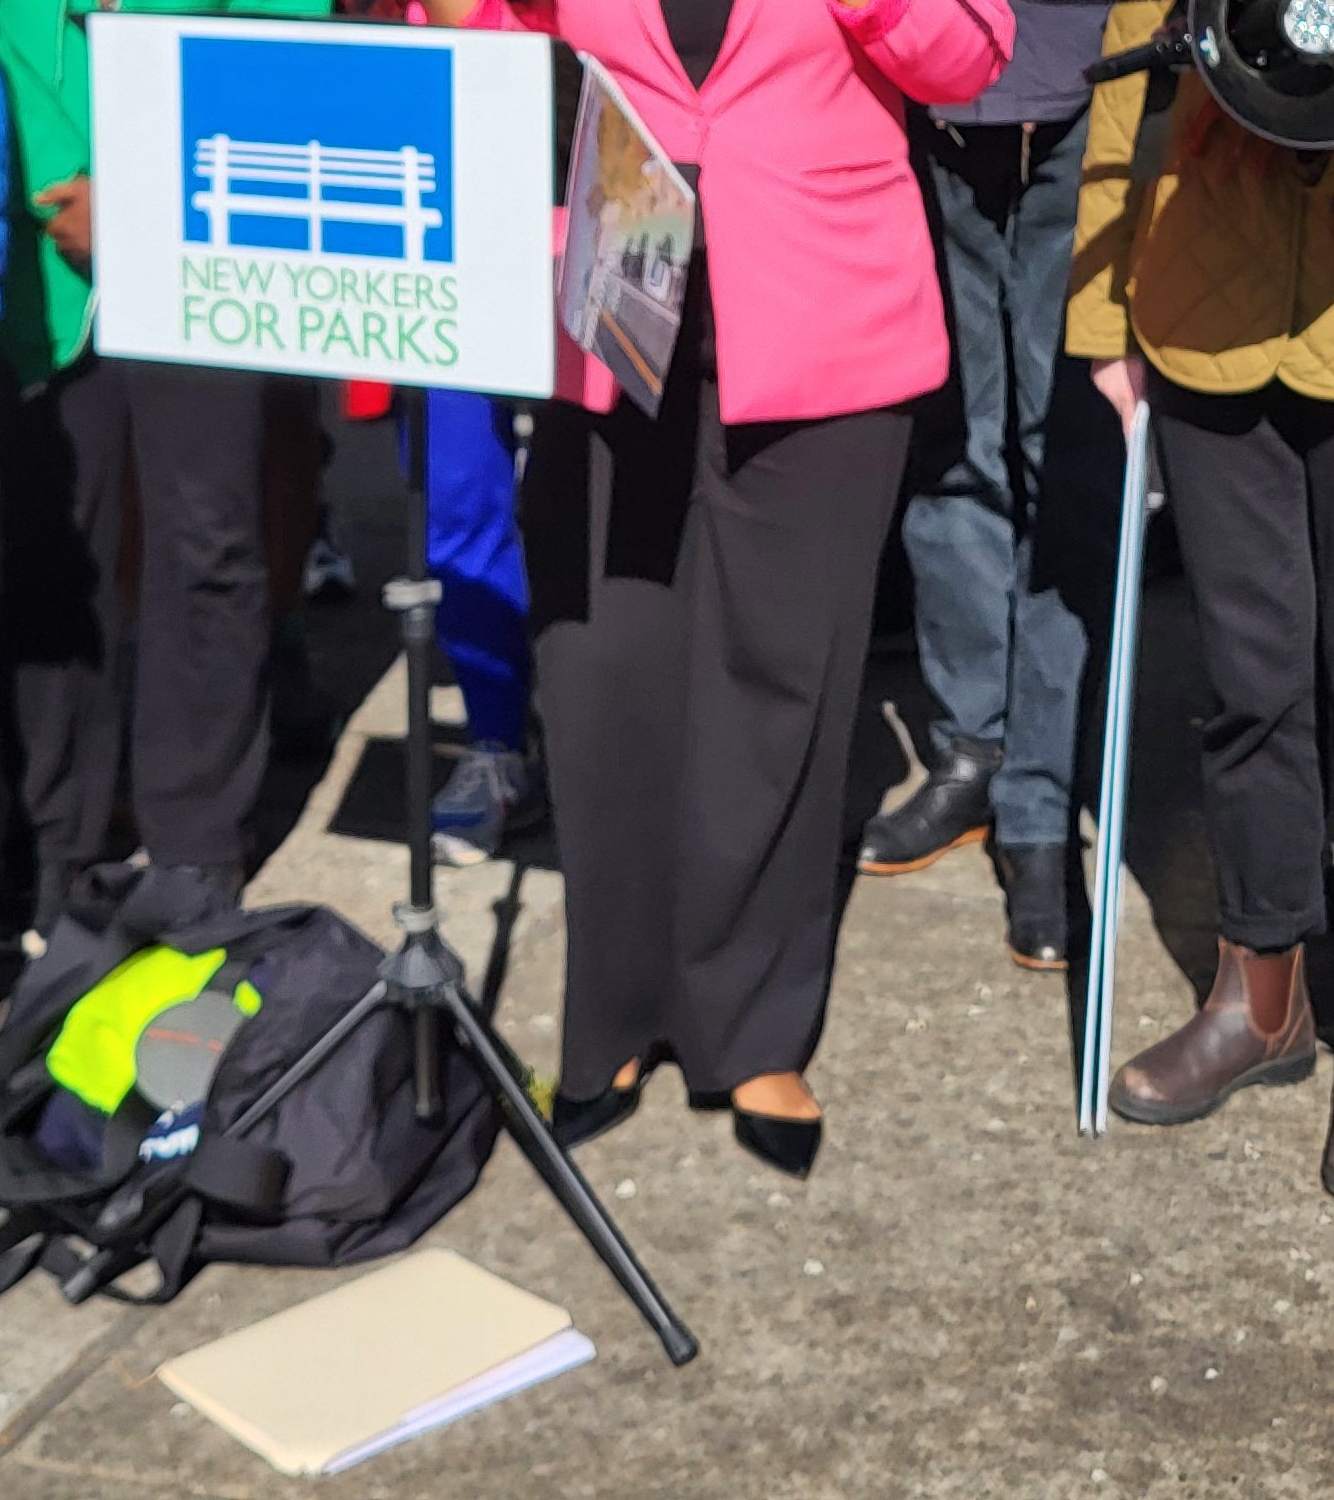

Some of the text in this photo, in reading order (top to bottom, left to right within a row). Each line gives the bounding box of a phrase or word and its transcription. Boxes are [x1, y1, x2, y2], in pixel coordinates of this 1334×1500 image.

[181, 255, 458, 312] NEW YORKERS
[183, 295, 459, 366] FOR PARKS
